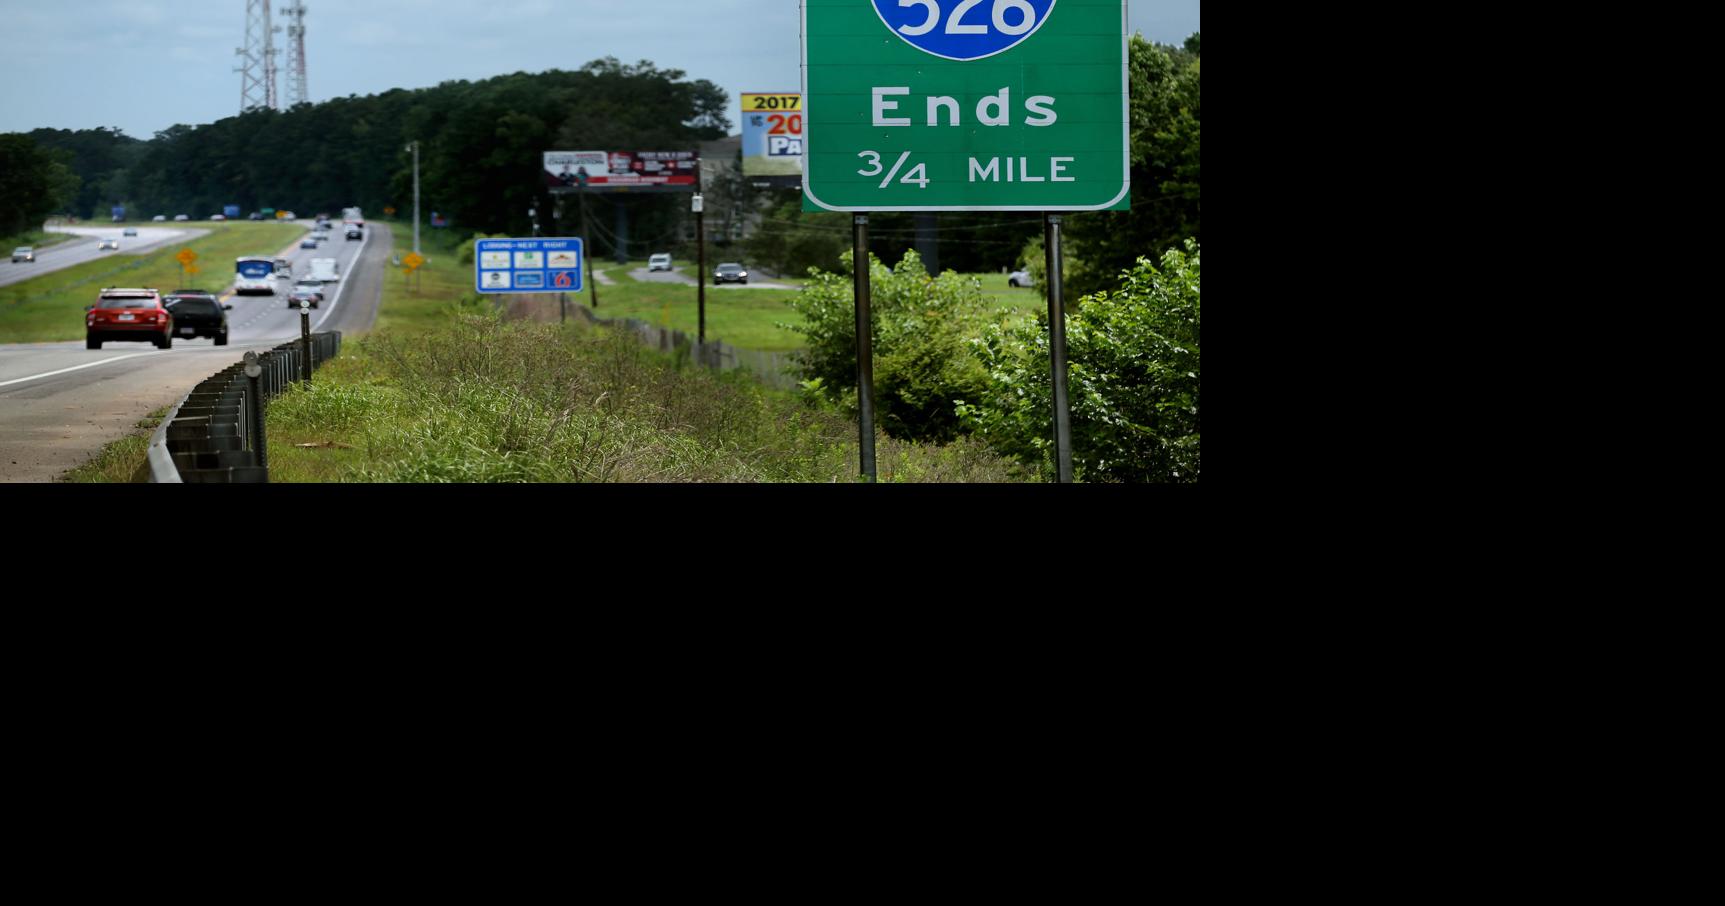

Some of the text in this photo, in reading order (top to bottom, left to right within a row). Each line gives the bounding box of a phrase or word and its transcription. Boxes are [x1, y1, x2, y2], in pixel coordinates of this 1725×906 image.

[897, 0, 1036, 36] 526
[754, 96, 800, 110] 2017
[871, 86, 1058, 127] Ends
[968, 156, 1076, 182] MILE
